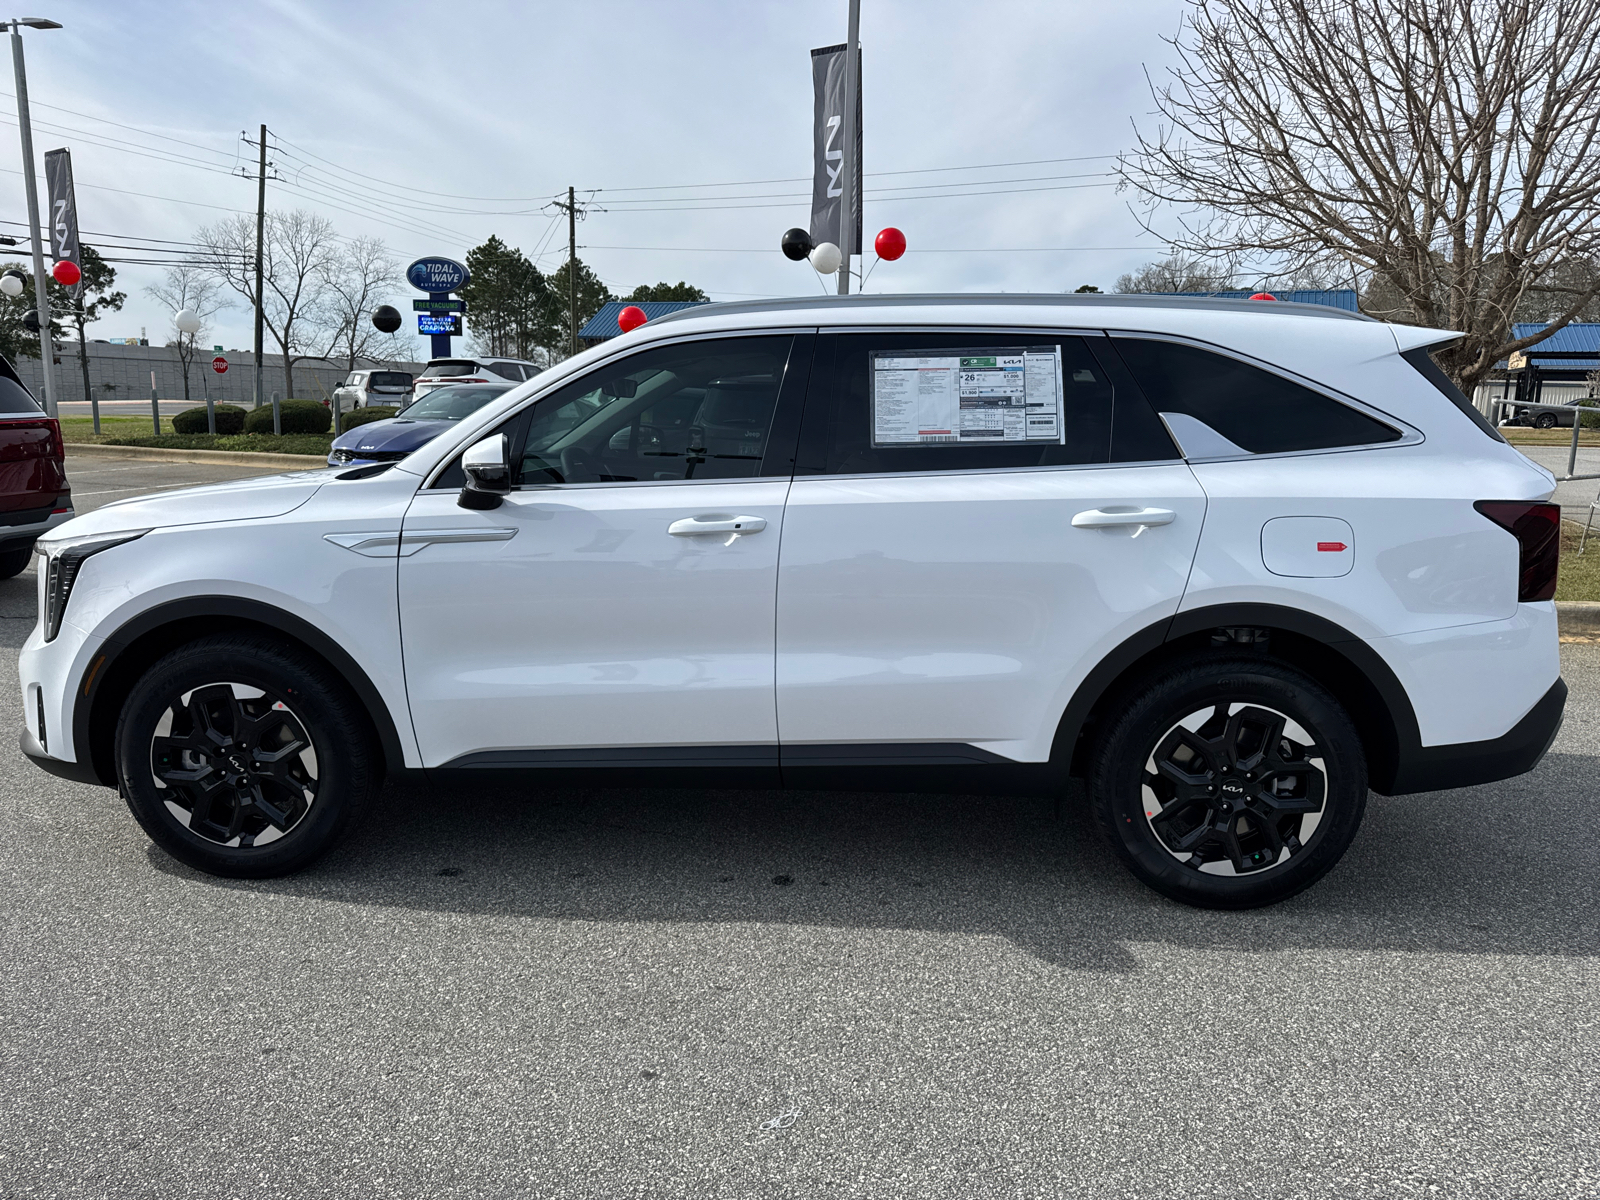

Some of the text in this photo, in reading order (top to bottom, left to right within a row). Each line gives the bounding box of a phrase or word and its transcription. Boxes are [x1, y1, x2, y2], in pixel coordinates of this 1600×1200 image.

[427, 264, 454, 273] TIDAL
[431, 273, 459, 282] WAVE
[415, 301, 458, 309] FREE VACUUMS
[964, 374, 976, 382] 26
[744, 430, 761, 438] Jeep
